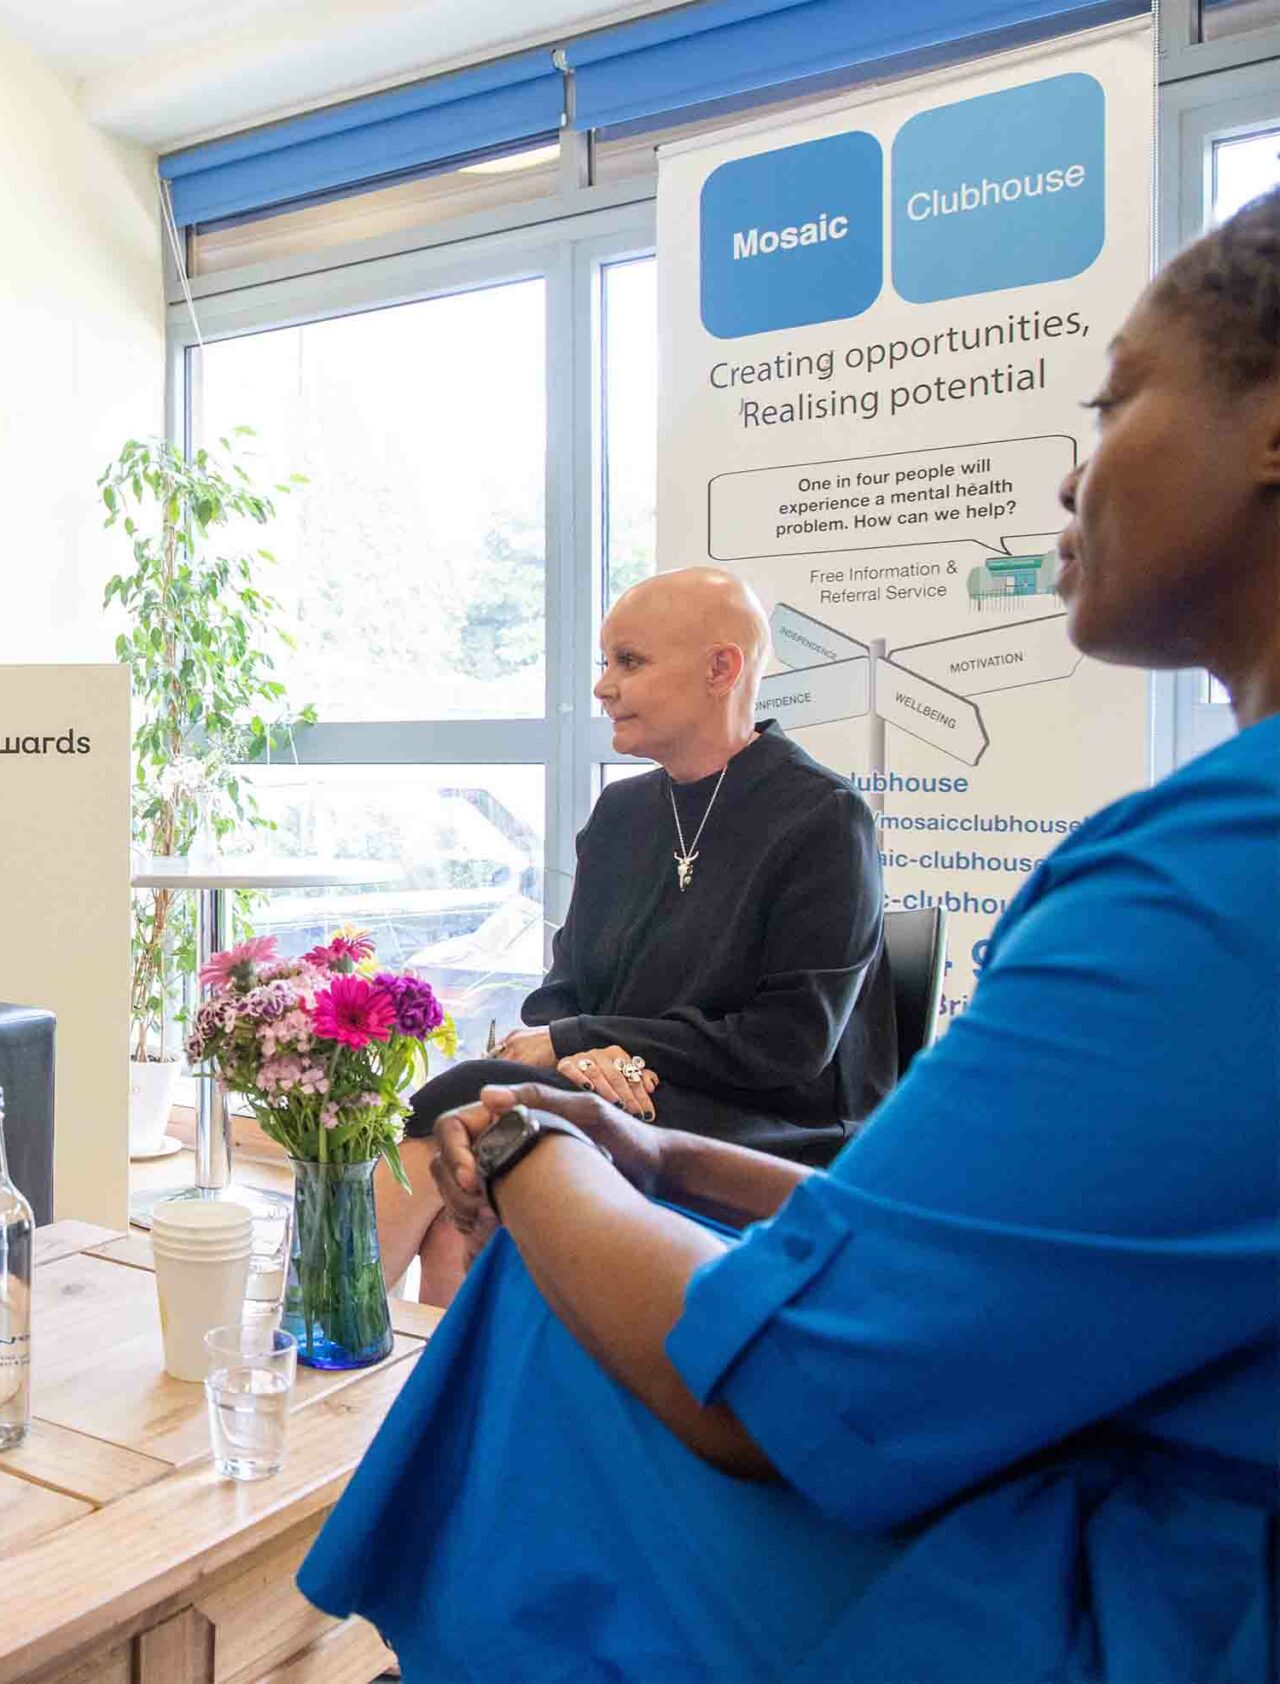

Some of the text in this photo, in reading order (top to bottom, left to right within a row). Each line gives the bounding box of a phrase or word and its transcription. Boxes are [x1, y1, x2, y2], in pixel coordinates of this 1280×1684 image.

[906, 163, 1087, 222] Clubhouse
[733, 213, 849, 260] Mosaic
[710, 311, 1090, 390] Creating opportunities,
[742, 359, 1046, 428] Realising potential
[798, 458, 991, 492] One in four people will
[779, 478, 1013, 516] experience a mental health
[776, 500, 1017, 538] problem. How can we help?
[810, 560, 958, 584] Free Information &
[820, 584, 947, 604] Referral Service
[778, 626, 839, 662] INDEPENDENCE
[949, 651, 1024, 674] MOTIVATION
[755, 692, 812, 711] NFIDENCE
[894, 692, 957, 730] WELLBEING
[850, 772, 969, 793] lubhouse
